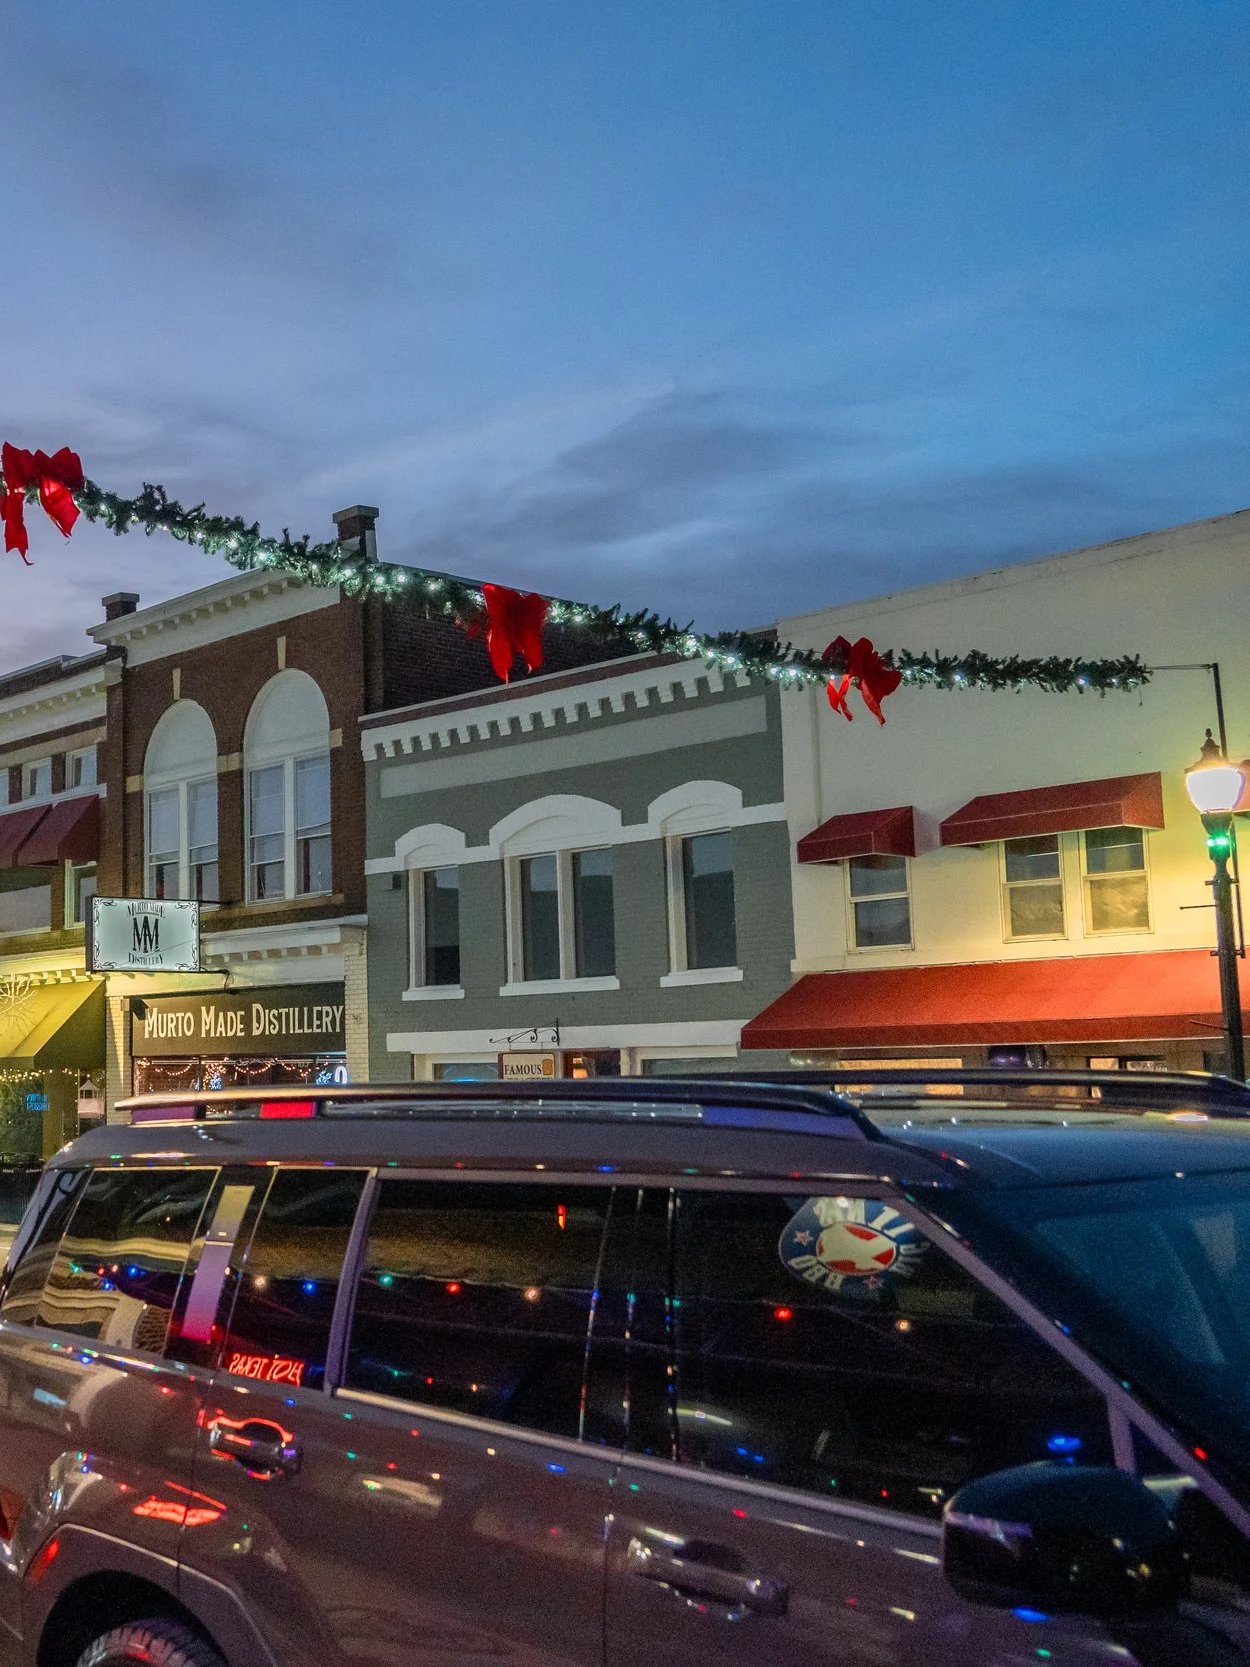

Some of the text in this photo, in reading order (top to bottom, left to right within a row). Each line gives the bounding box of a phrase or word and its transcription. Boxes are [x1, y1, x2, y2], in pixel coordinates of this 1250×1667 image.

[128, 952, 164, 966] DISTILLERY
[144, 1003, 344, 1039] MURTO MADE DISTILLERY
[504, 1064, 542, 1076] FAMOUS
